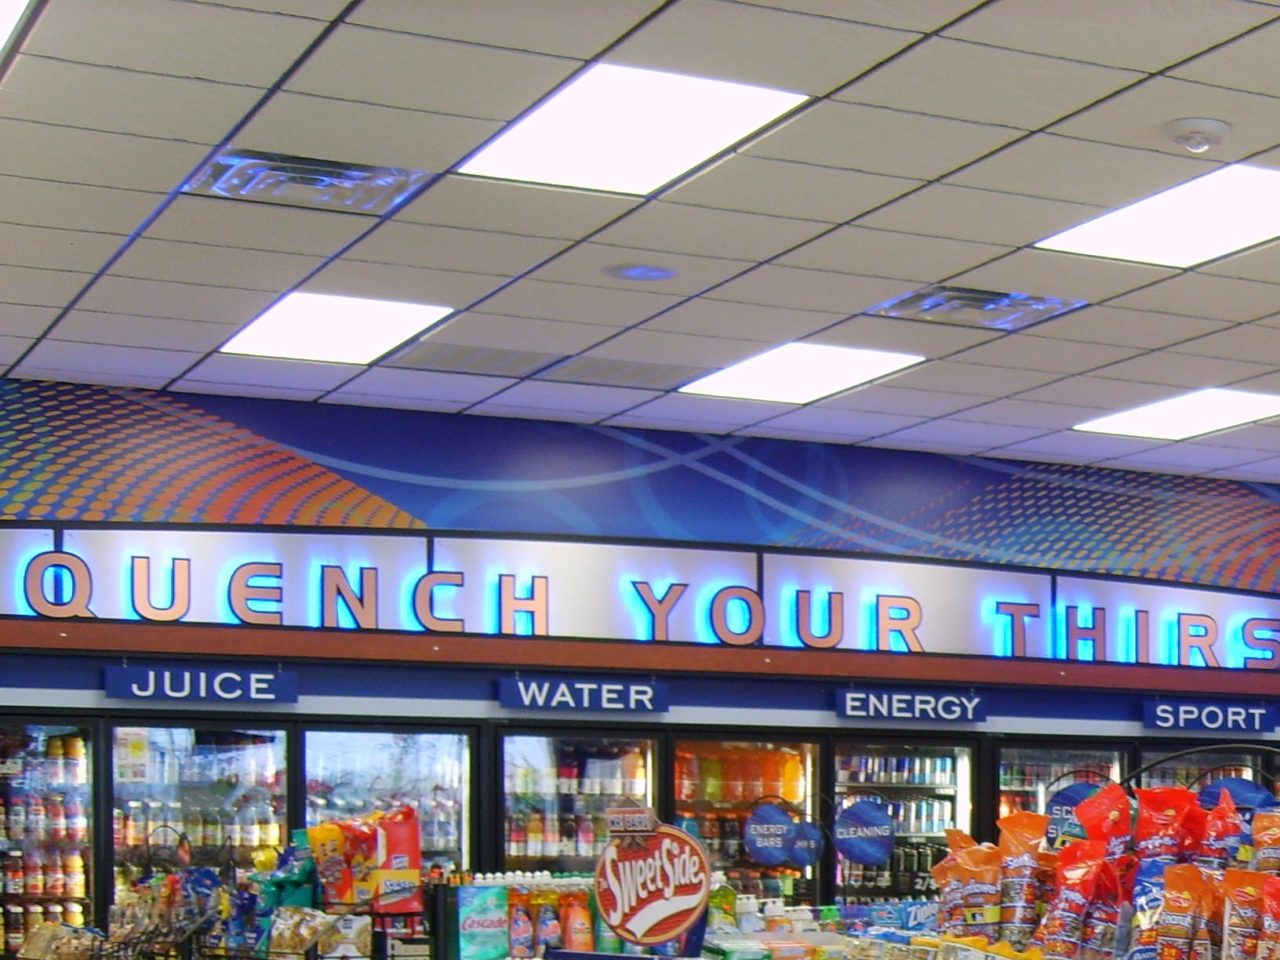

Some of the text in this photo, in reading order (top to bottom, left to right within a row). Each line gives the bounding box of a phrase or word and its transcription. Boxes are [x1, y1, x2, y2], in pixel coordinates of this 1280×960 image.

[24, 550, 549, 636] QUENCH
[632, 582, 923, 653] YOUR
[131, 671, 275, 700] JUICE
[517, 681, 654, 710] WATER
[845, 693, 981, 722] ENERGY
[1155, 705, 1267, 732] SPORT
[750, 824, 787, 835] ENERGY
[755, 836, 782, 848] BARS
[837, 825, 890, 839] CLEANING
[603, 838, 700, 926] Sweet Side
[462, 914, 508, 932] Cascade
